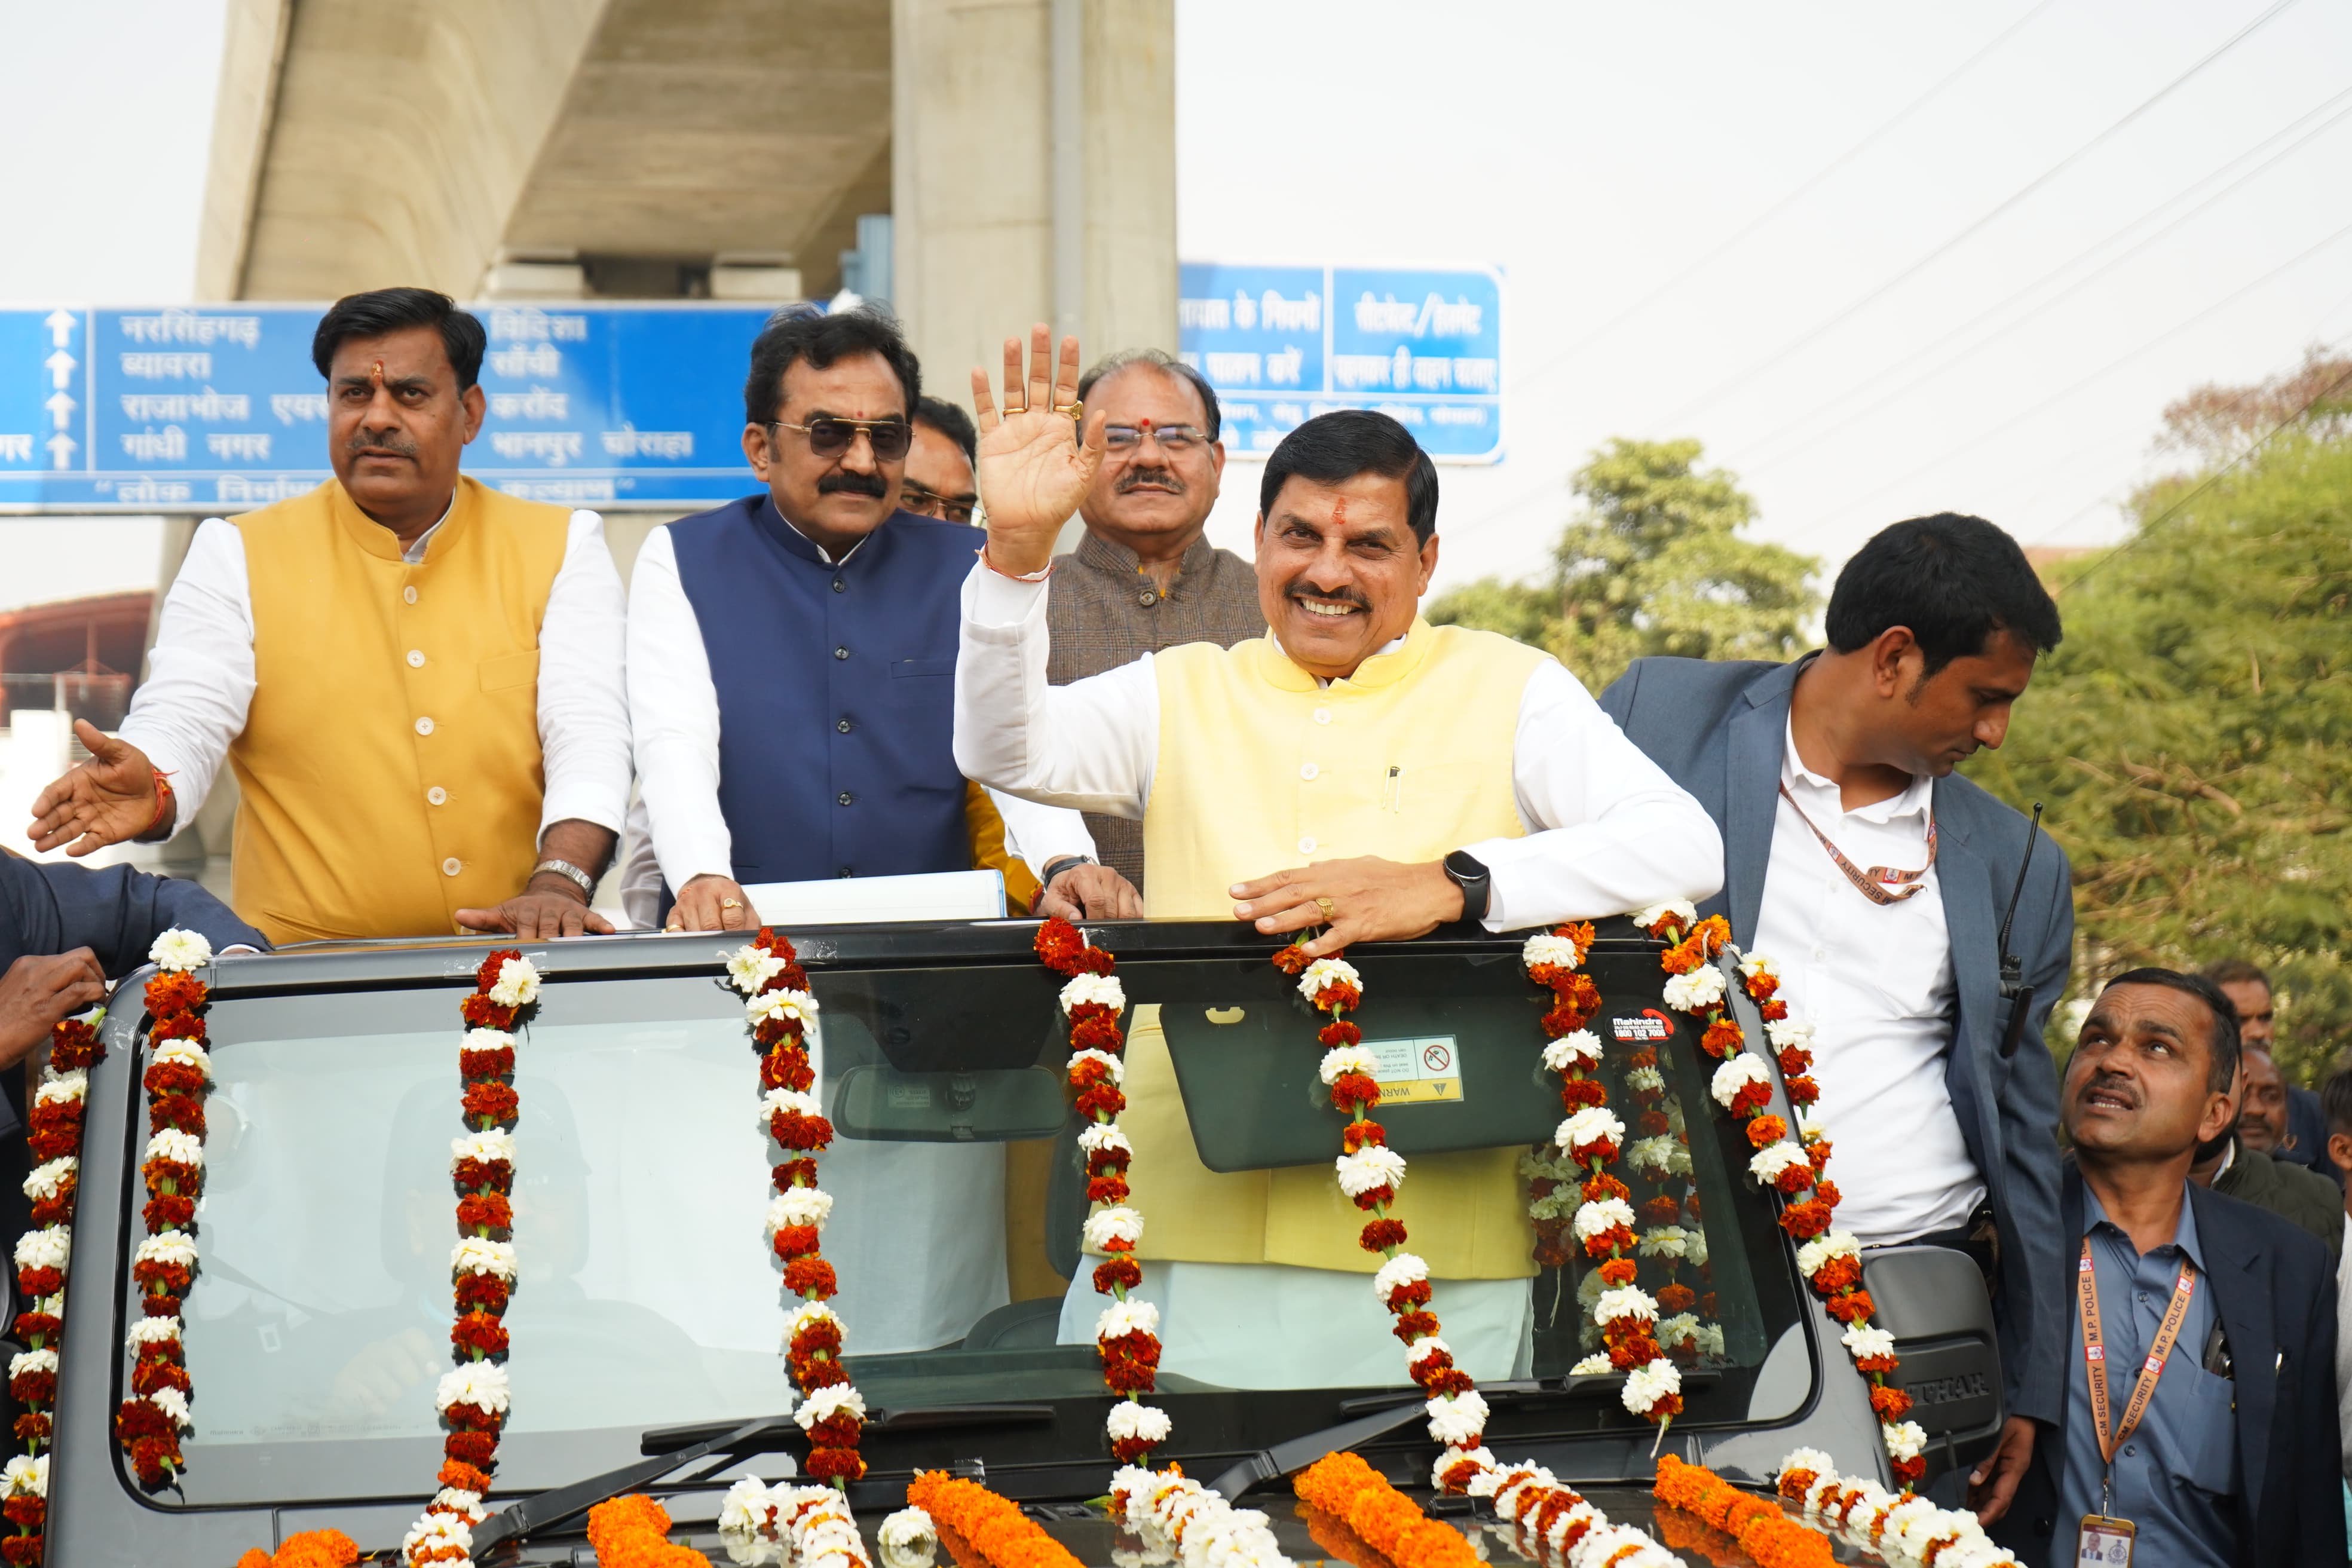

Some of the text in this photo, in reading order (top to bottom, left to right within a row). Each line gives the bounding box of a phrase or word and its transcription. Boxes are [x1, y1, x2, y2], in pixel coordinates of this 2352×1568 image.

[119, 352, 211, 380] ब्यावरा
[120, 385, 249, 420] राजाभोज
[0, 434, 33, 462] गर
[120, 424, 271, 460] गांधी नगर
[1841, 861, 1882, 899] SECURITY
[1380, 1088, 1410, 1097] WARN
[2082, 1276, 2098, 1341] M.P. POLICE
[2155, 1294, 2185, 1355] M.P. POLICE
[1906, 1371, 1989, 1405] THAR
[2093, 1366, 2108, 1437] CM SECURITY
[2118, 1376, 2152, 1441] CM SECURITY
